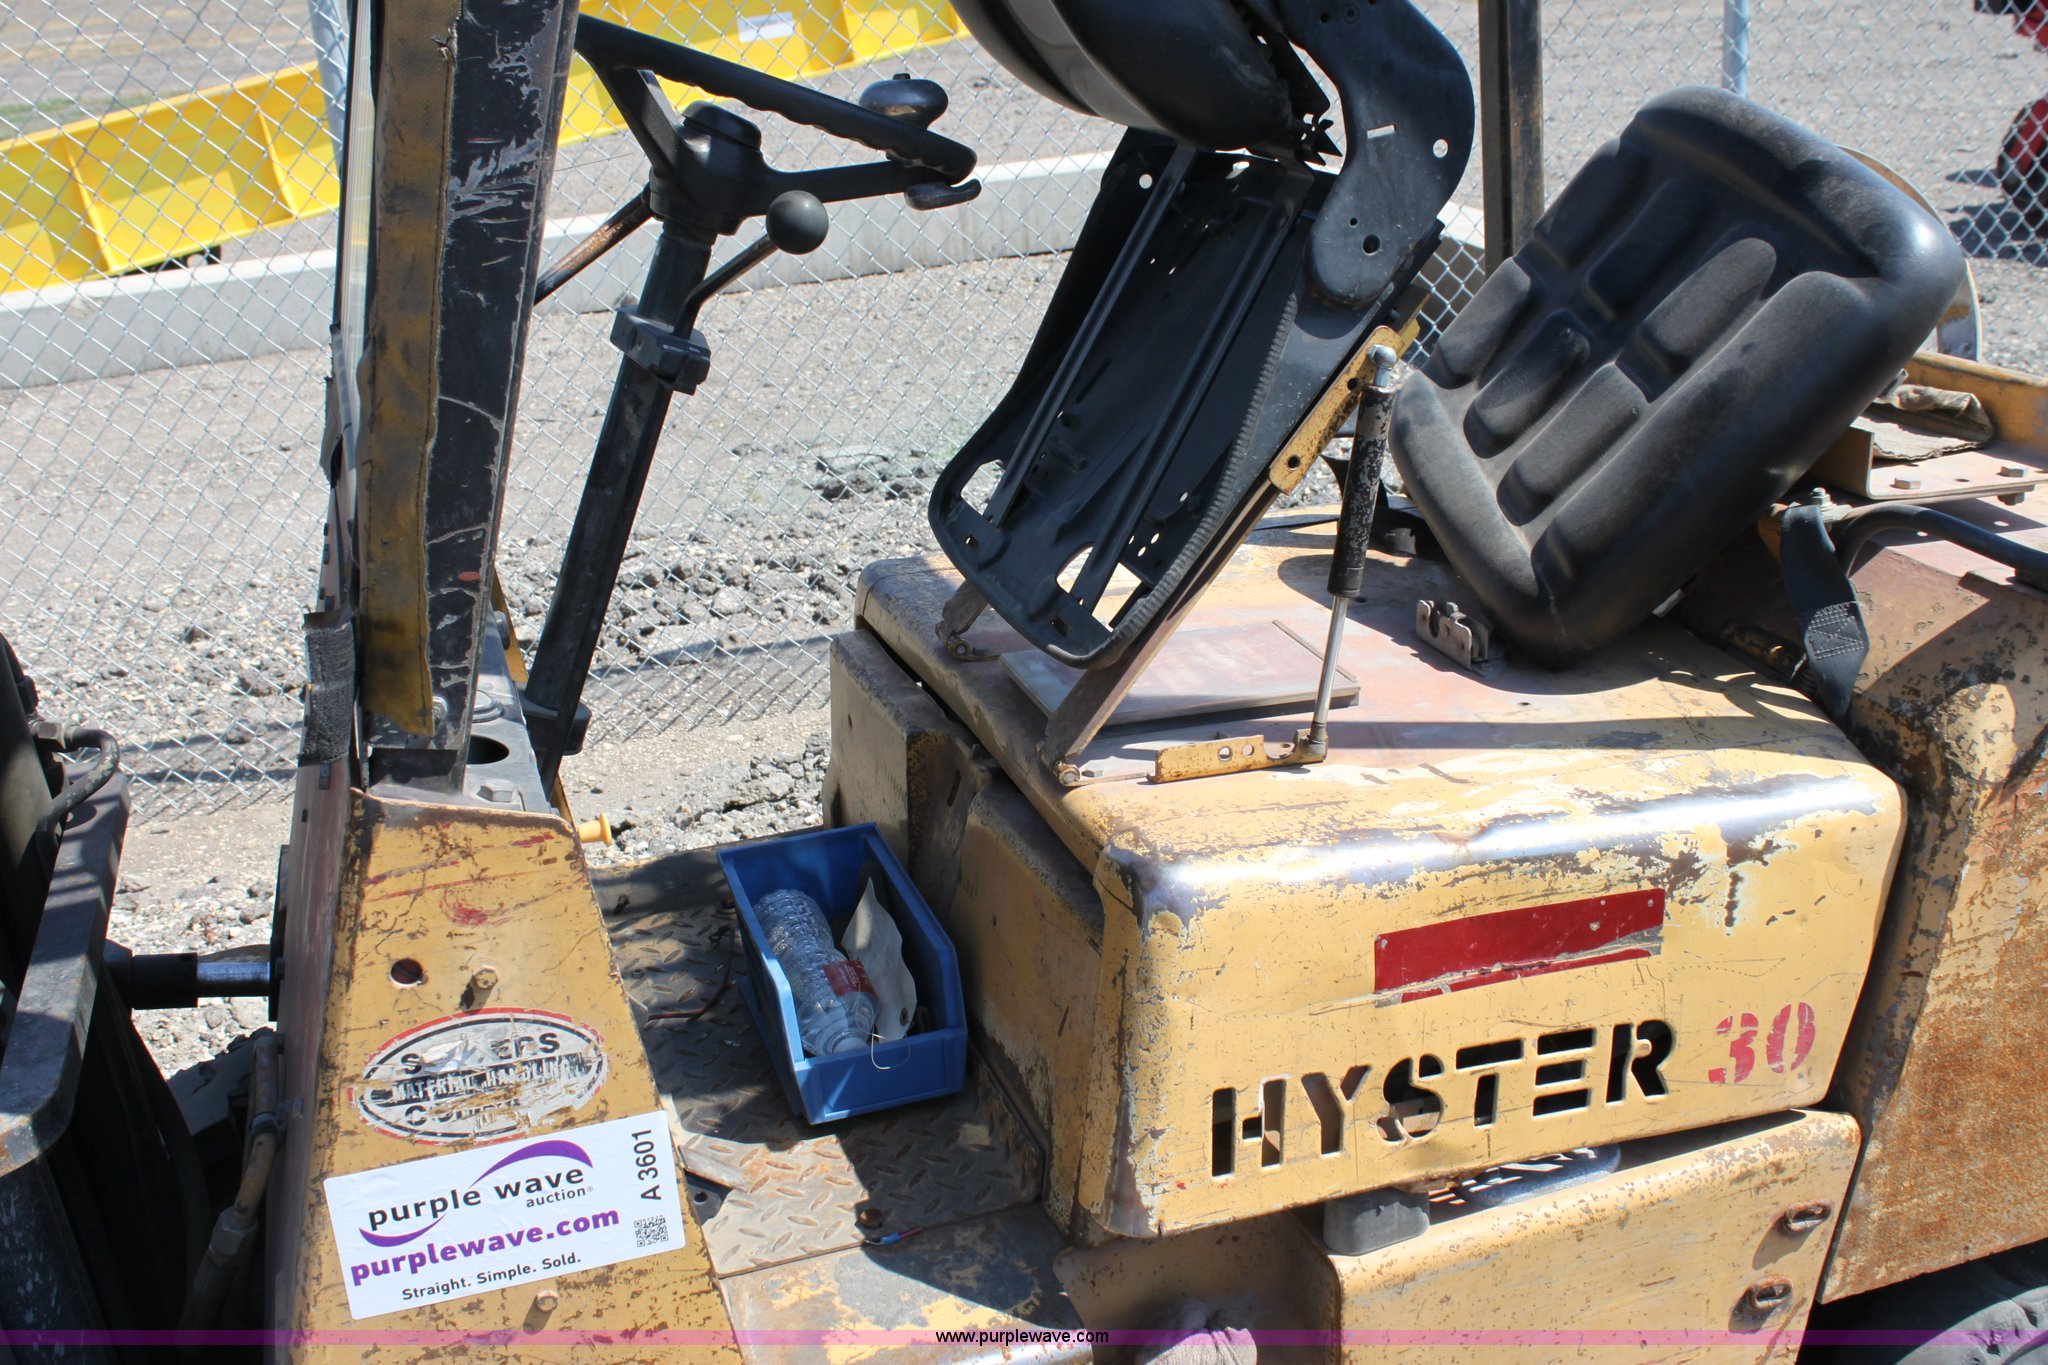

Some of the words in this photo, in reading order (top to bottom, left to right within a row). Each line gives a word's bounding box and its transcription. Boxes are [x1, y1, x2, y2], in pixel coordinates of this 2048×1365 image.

[1211, 1019, 1677, 1177] HYSTER
[1707, 1001, 1817, 1085] 30
[631, 1129, 658, 1181] 3601
[368, 1188, 481, 1231] purple
[494, 1168, 584, 1199] wave
[641, 1184, 661, 1200] A
[351, 1209, 620, 1286] purplewave.com
[402, 1276, 471, 1300] Straight.
[477, 1264, 536, 1284] Simple.
[542, 1252, 581, 1270] Sold.
